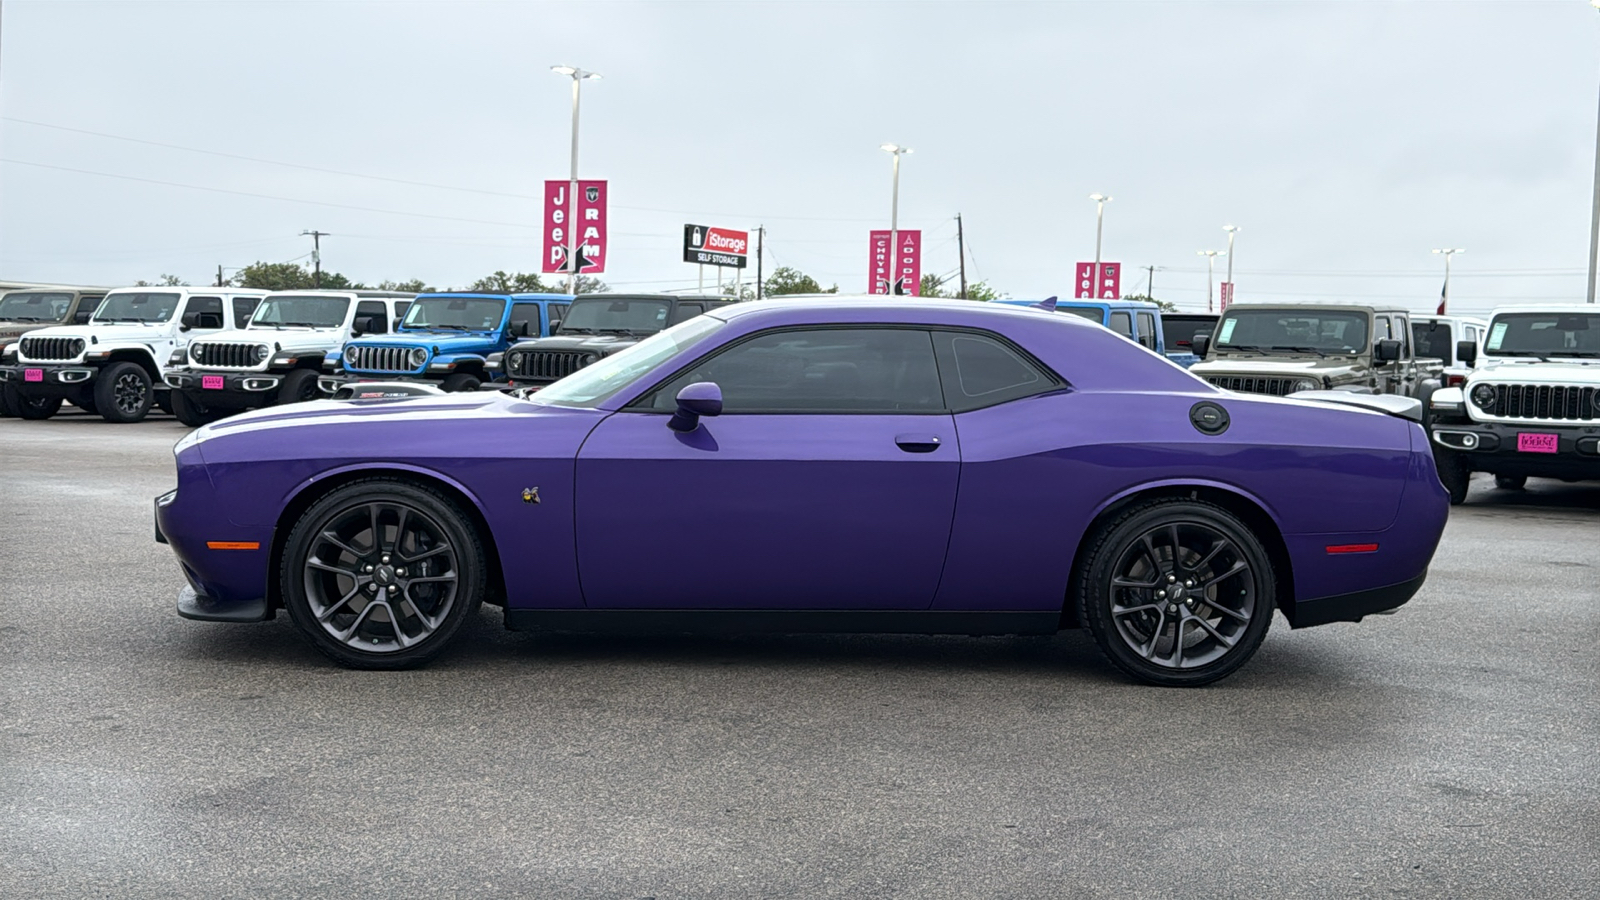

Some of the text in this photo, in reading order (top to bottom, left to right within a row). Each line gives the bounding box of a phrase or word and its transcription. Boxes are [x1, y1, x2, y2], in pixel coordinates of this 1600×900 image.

[551, 186, 564, 264] Jeep
[584, 208, 600, 256] RAM
[709, 231, 746, 253] iStorage
[697, 252, 739, 265] SELF STORAGE
[876, 240, 885, 294] CHRYSLER
[1081, 266, 1090, 298] Jee
[1103, 279, 1114, 298] RA
